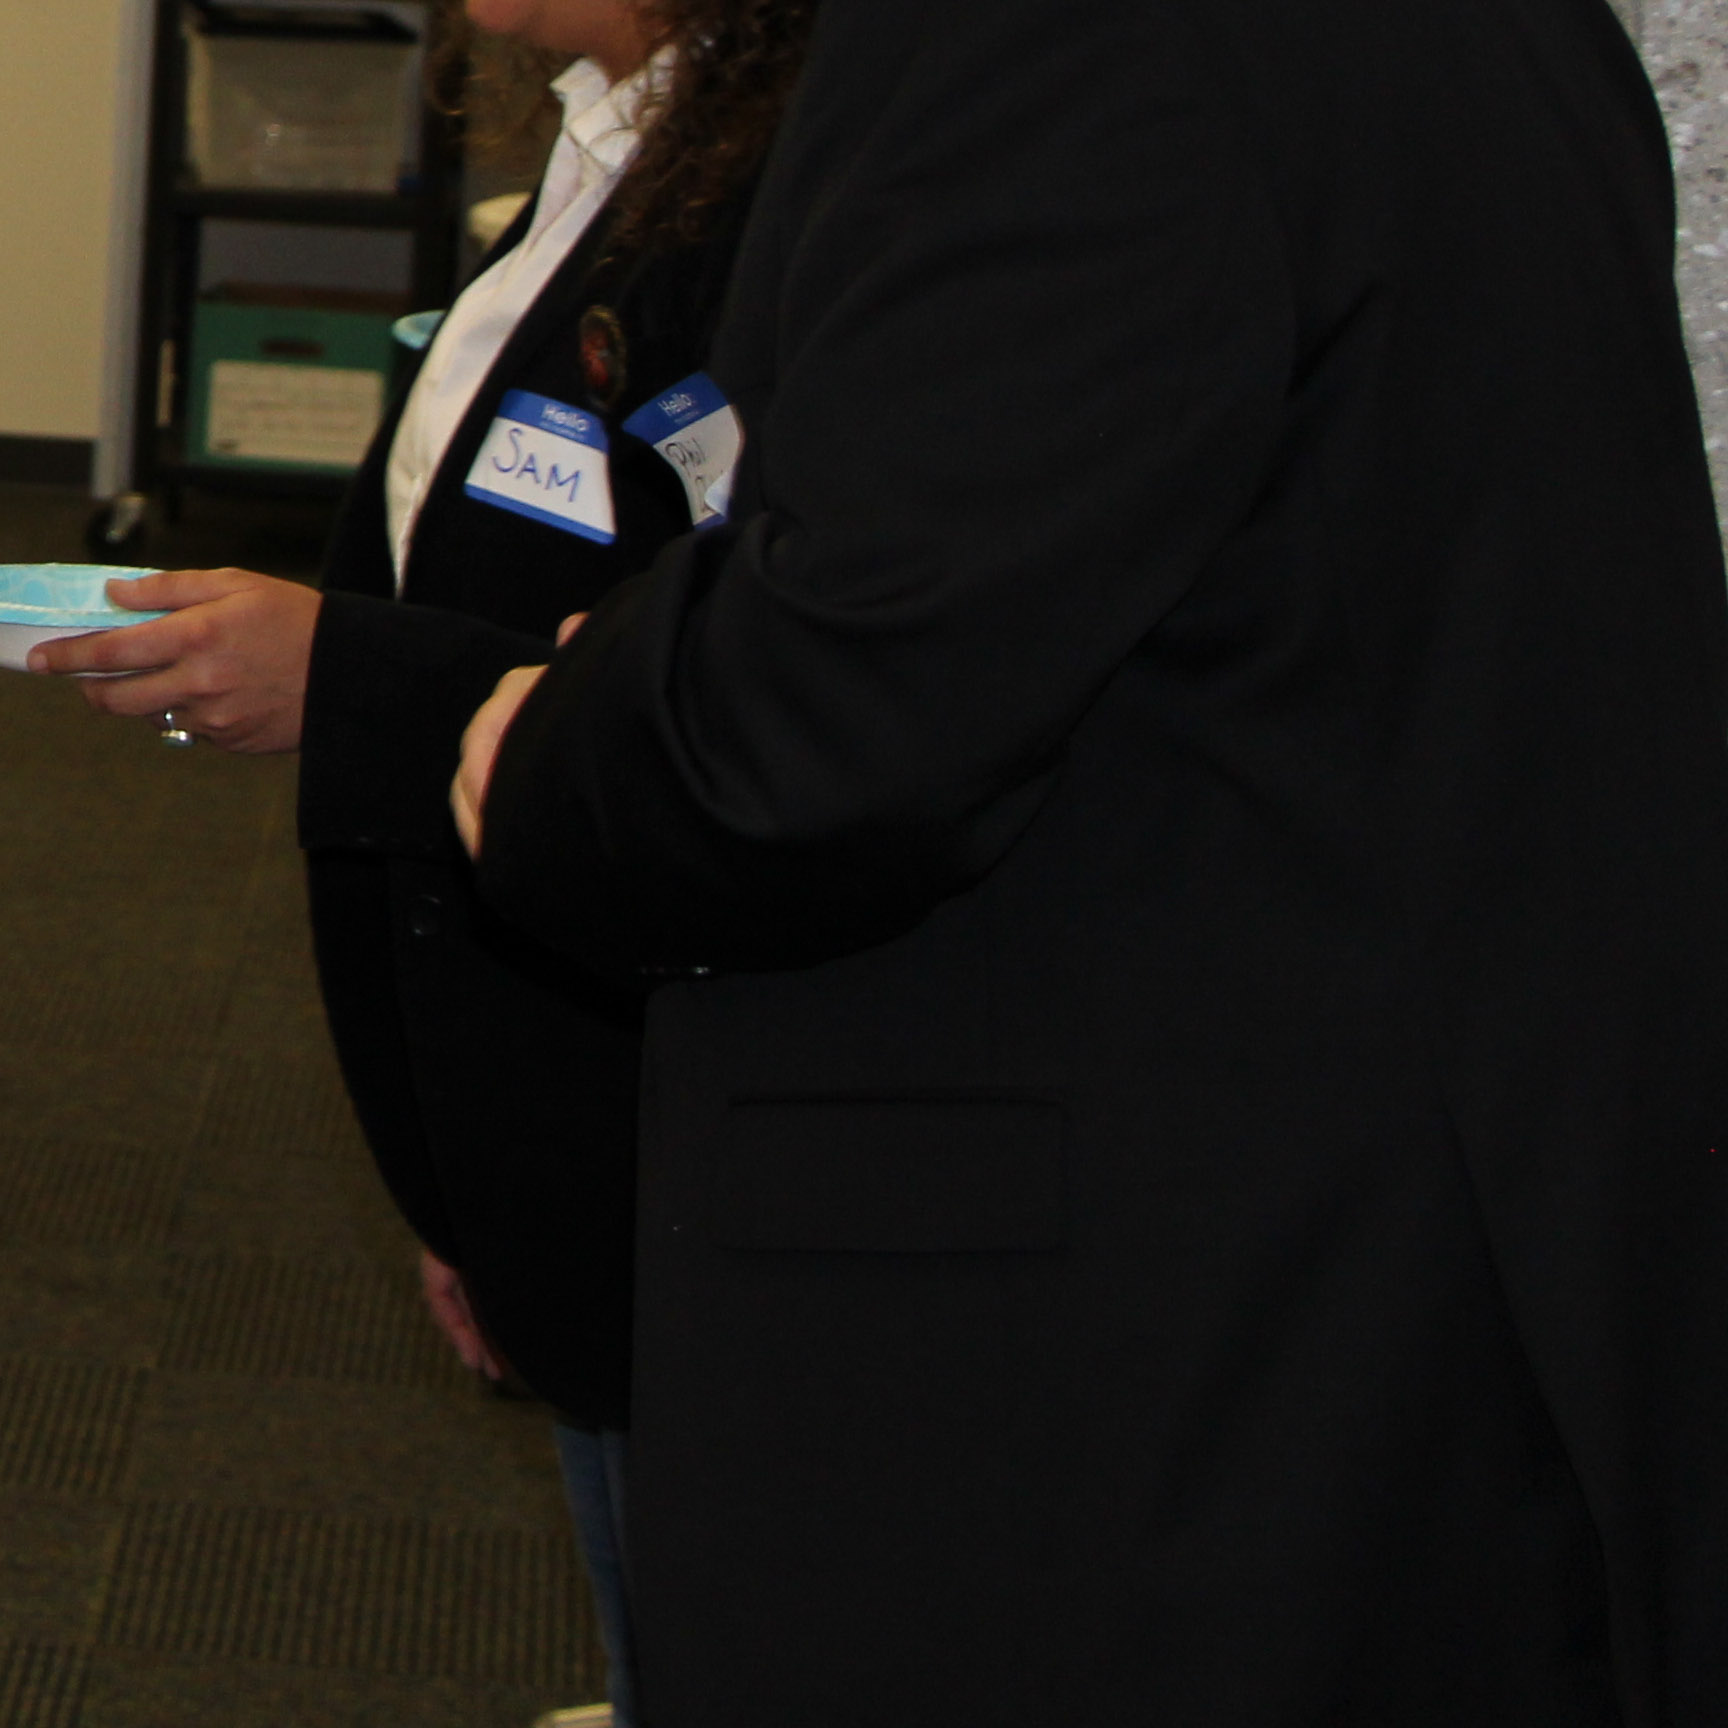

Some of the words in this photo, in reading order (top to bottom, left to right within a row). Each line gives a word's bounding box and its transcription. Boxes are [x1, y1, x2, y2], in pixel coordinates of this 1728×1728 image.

[542, 403, 589, 432] Hello
[657, 392, 693, 417] Hello
[492, 427, 581, 503] SAM
